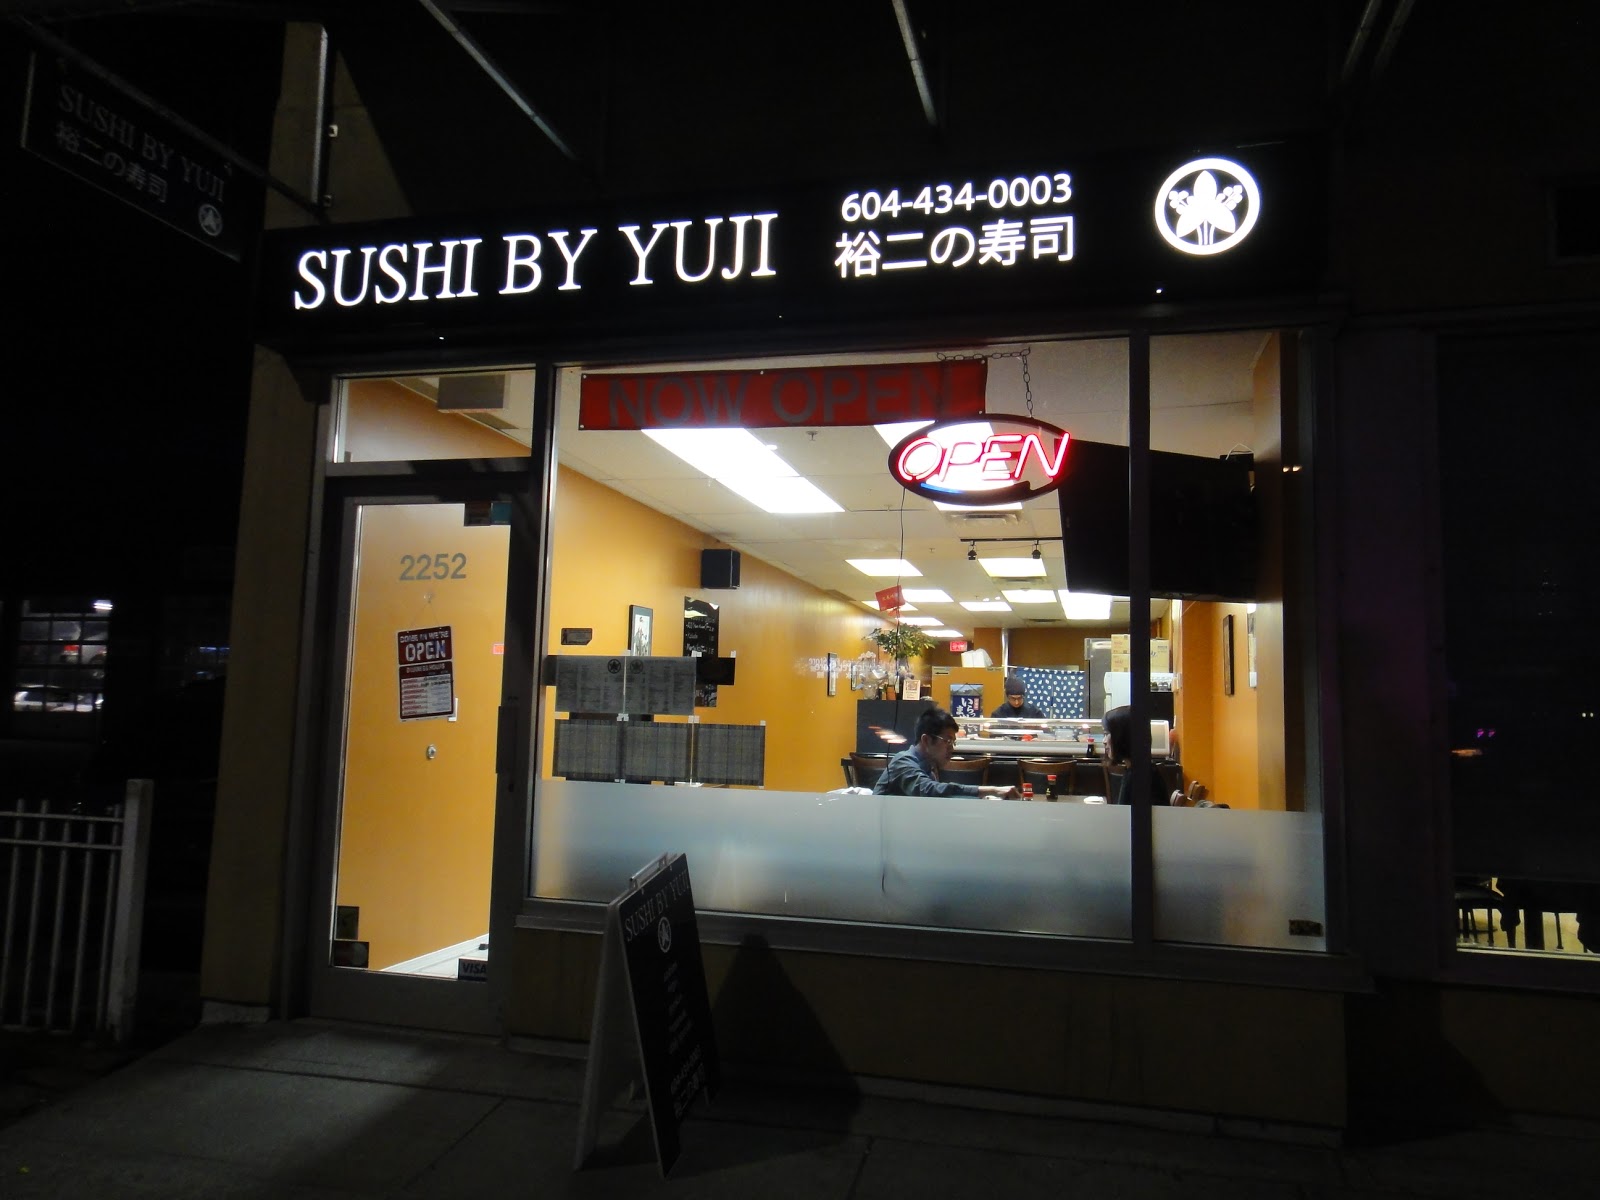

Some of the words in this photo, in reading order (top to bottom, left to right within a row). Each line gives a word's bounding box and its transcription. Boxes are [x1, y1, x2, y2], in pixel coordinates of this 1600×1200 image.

[57, 84, 136, 150] SUSHI
[142, 132, 174, 170] BY
[181, 156, 225, 203] YUJI
[840, 172, 1073, 223] 604-434-0003
[293, 237, 483, 311] SUSHI
[498, 228, 598, 295] BY
[618, 212, 779, 287] YUJI
[834, 214, 1075, 280] 裕二の寿司
[608, 376, 746, 428] NOW
[771, 369, 952, 425] OPEN
[896, 430, 1071, 483] OPEN
[399, 552, 467, 582] 2252
[405, 640, 446, 662] OPEN
[624, 898, 656, 943] SUSHI
[655, 886, 669, 915] BY
[463, 962, 487, 974] VISA
